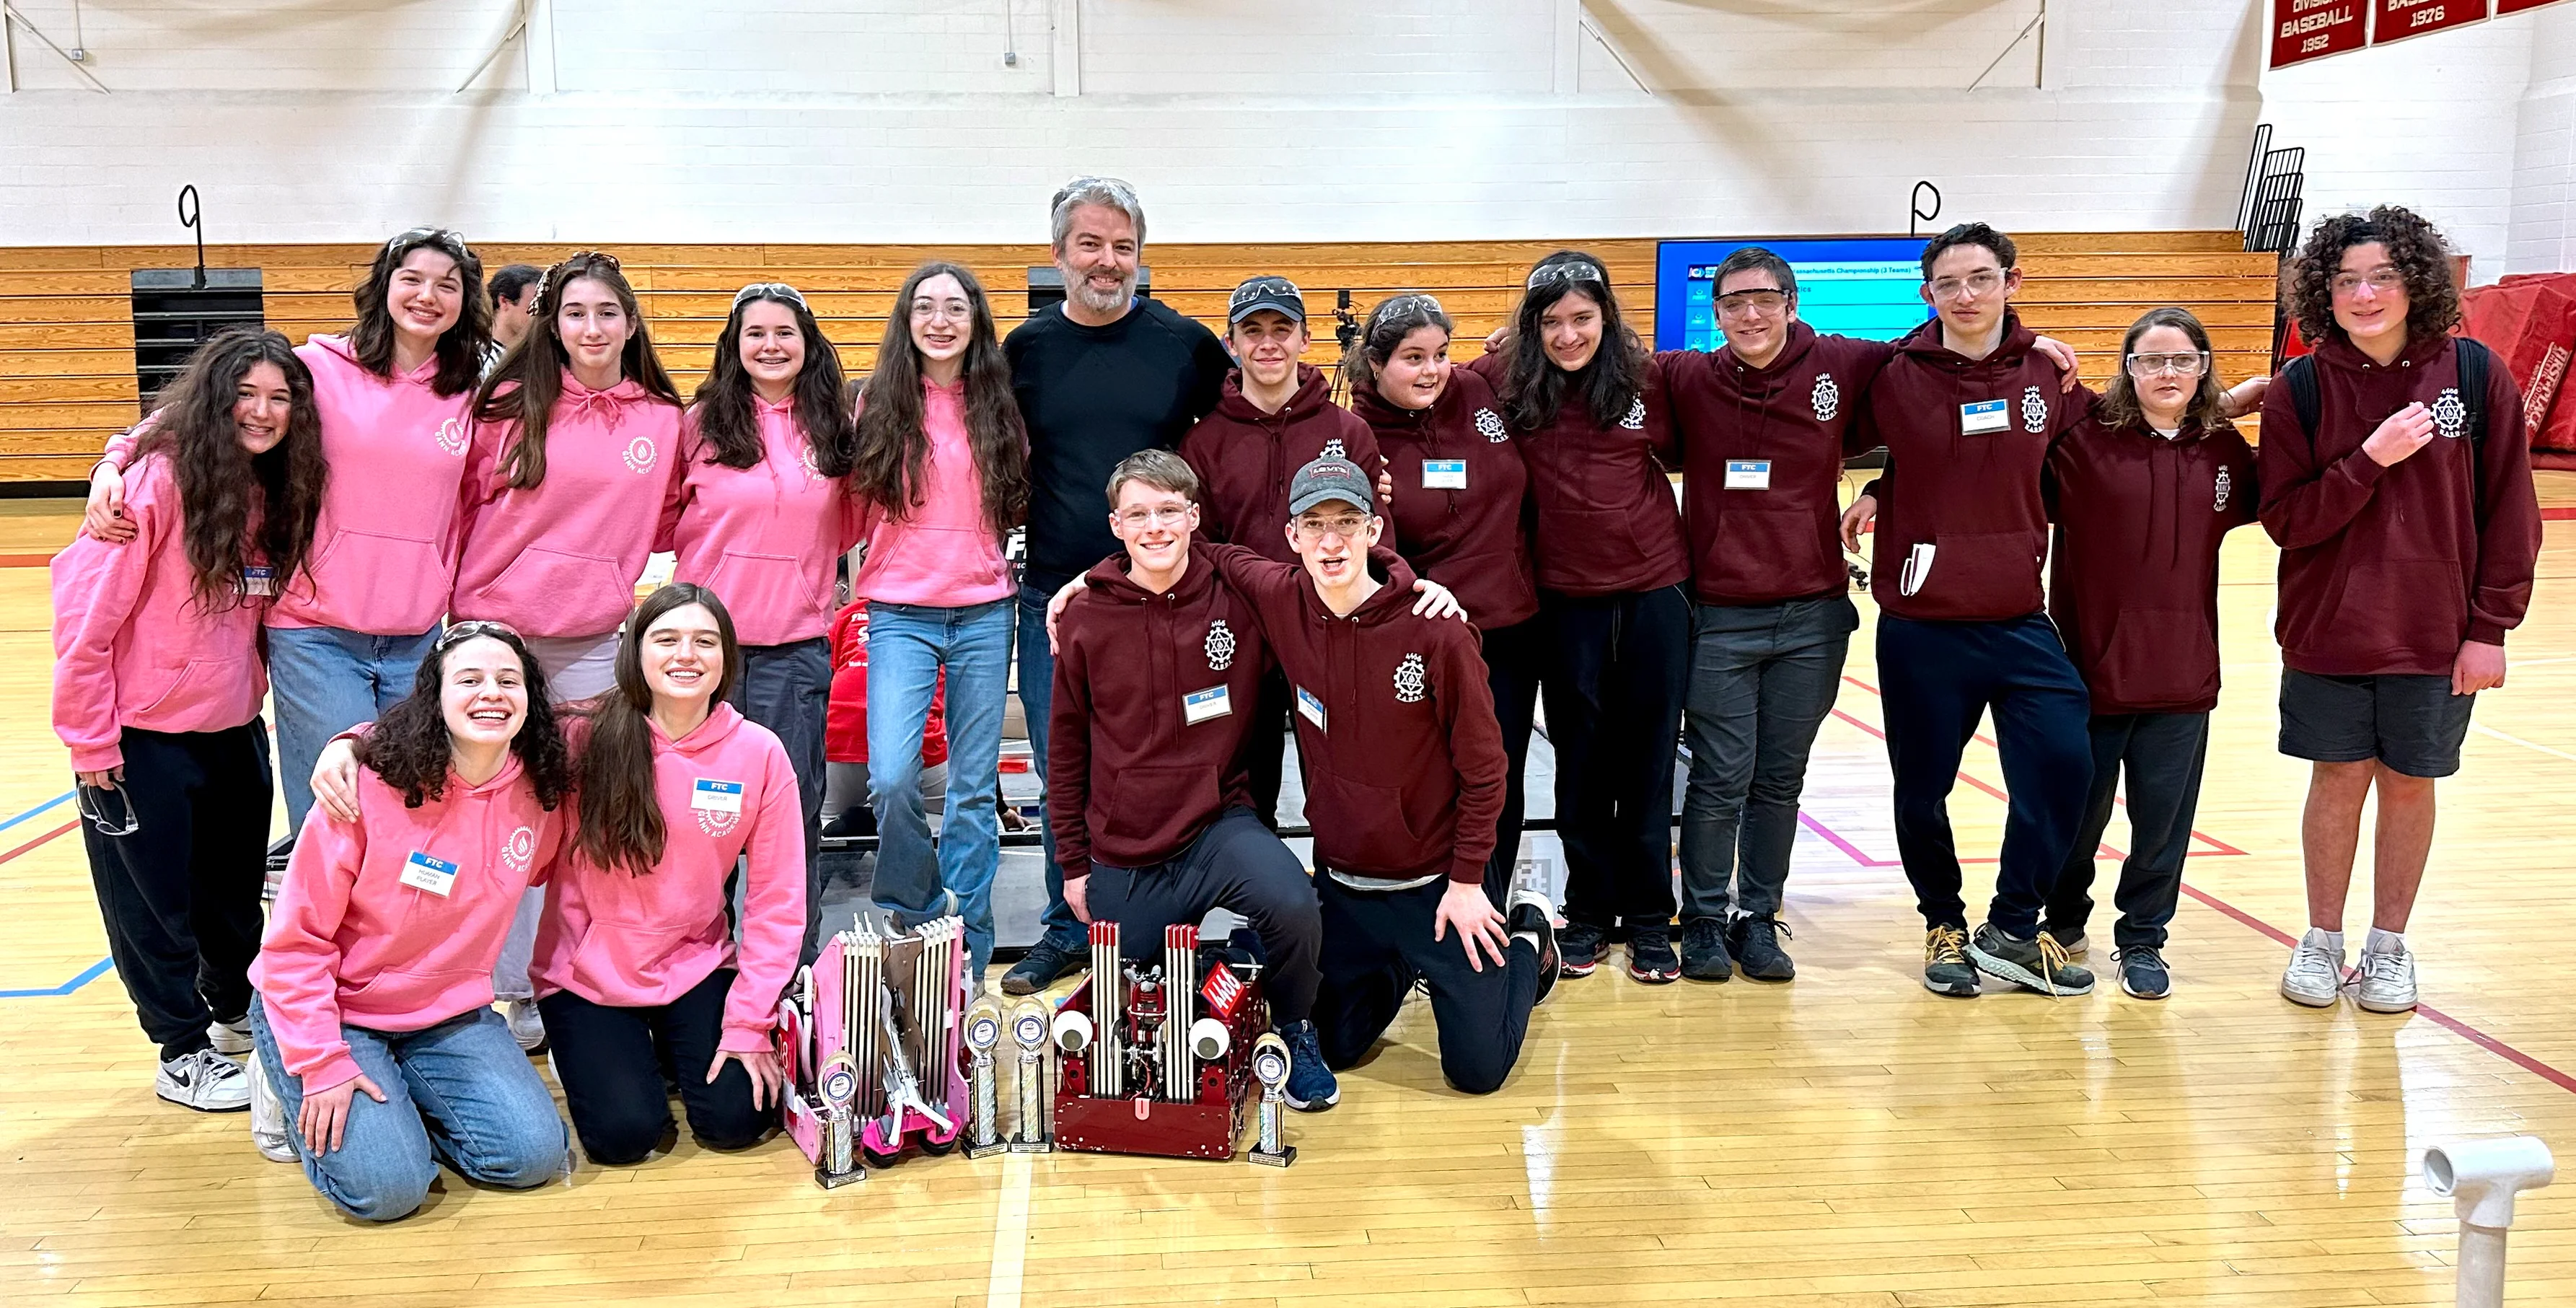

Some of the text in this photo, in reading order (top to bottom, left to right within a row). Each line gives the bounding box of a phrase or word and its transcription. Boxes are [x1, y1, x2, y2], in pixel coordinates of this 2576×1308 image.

[2293, 0, 2338, 12] DIVIS
[2280, 5, 2354, 38] BASEBALL
[2410, 5, 2445, 27] 1976
[2300, 34, 2330, 53] 1952
[1977, 403, 1993, 412] FTC
[434, 431, 449, 452] GANN
[622, 450, 636, 471] GANN
[1199, 691, 1214, 701] FTC
[711, 782, 729, 791] FTC
[698, 810, 712, 835] GANN
[424, 856, 444, 869] FTC
[501, 846, 516, 870] GANN
[416, 875, 437, 886] PLAYER
[418, 869, 441, 879] HUMAN
[1207, 967, 1241, 1009] 4466
